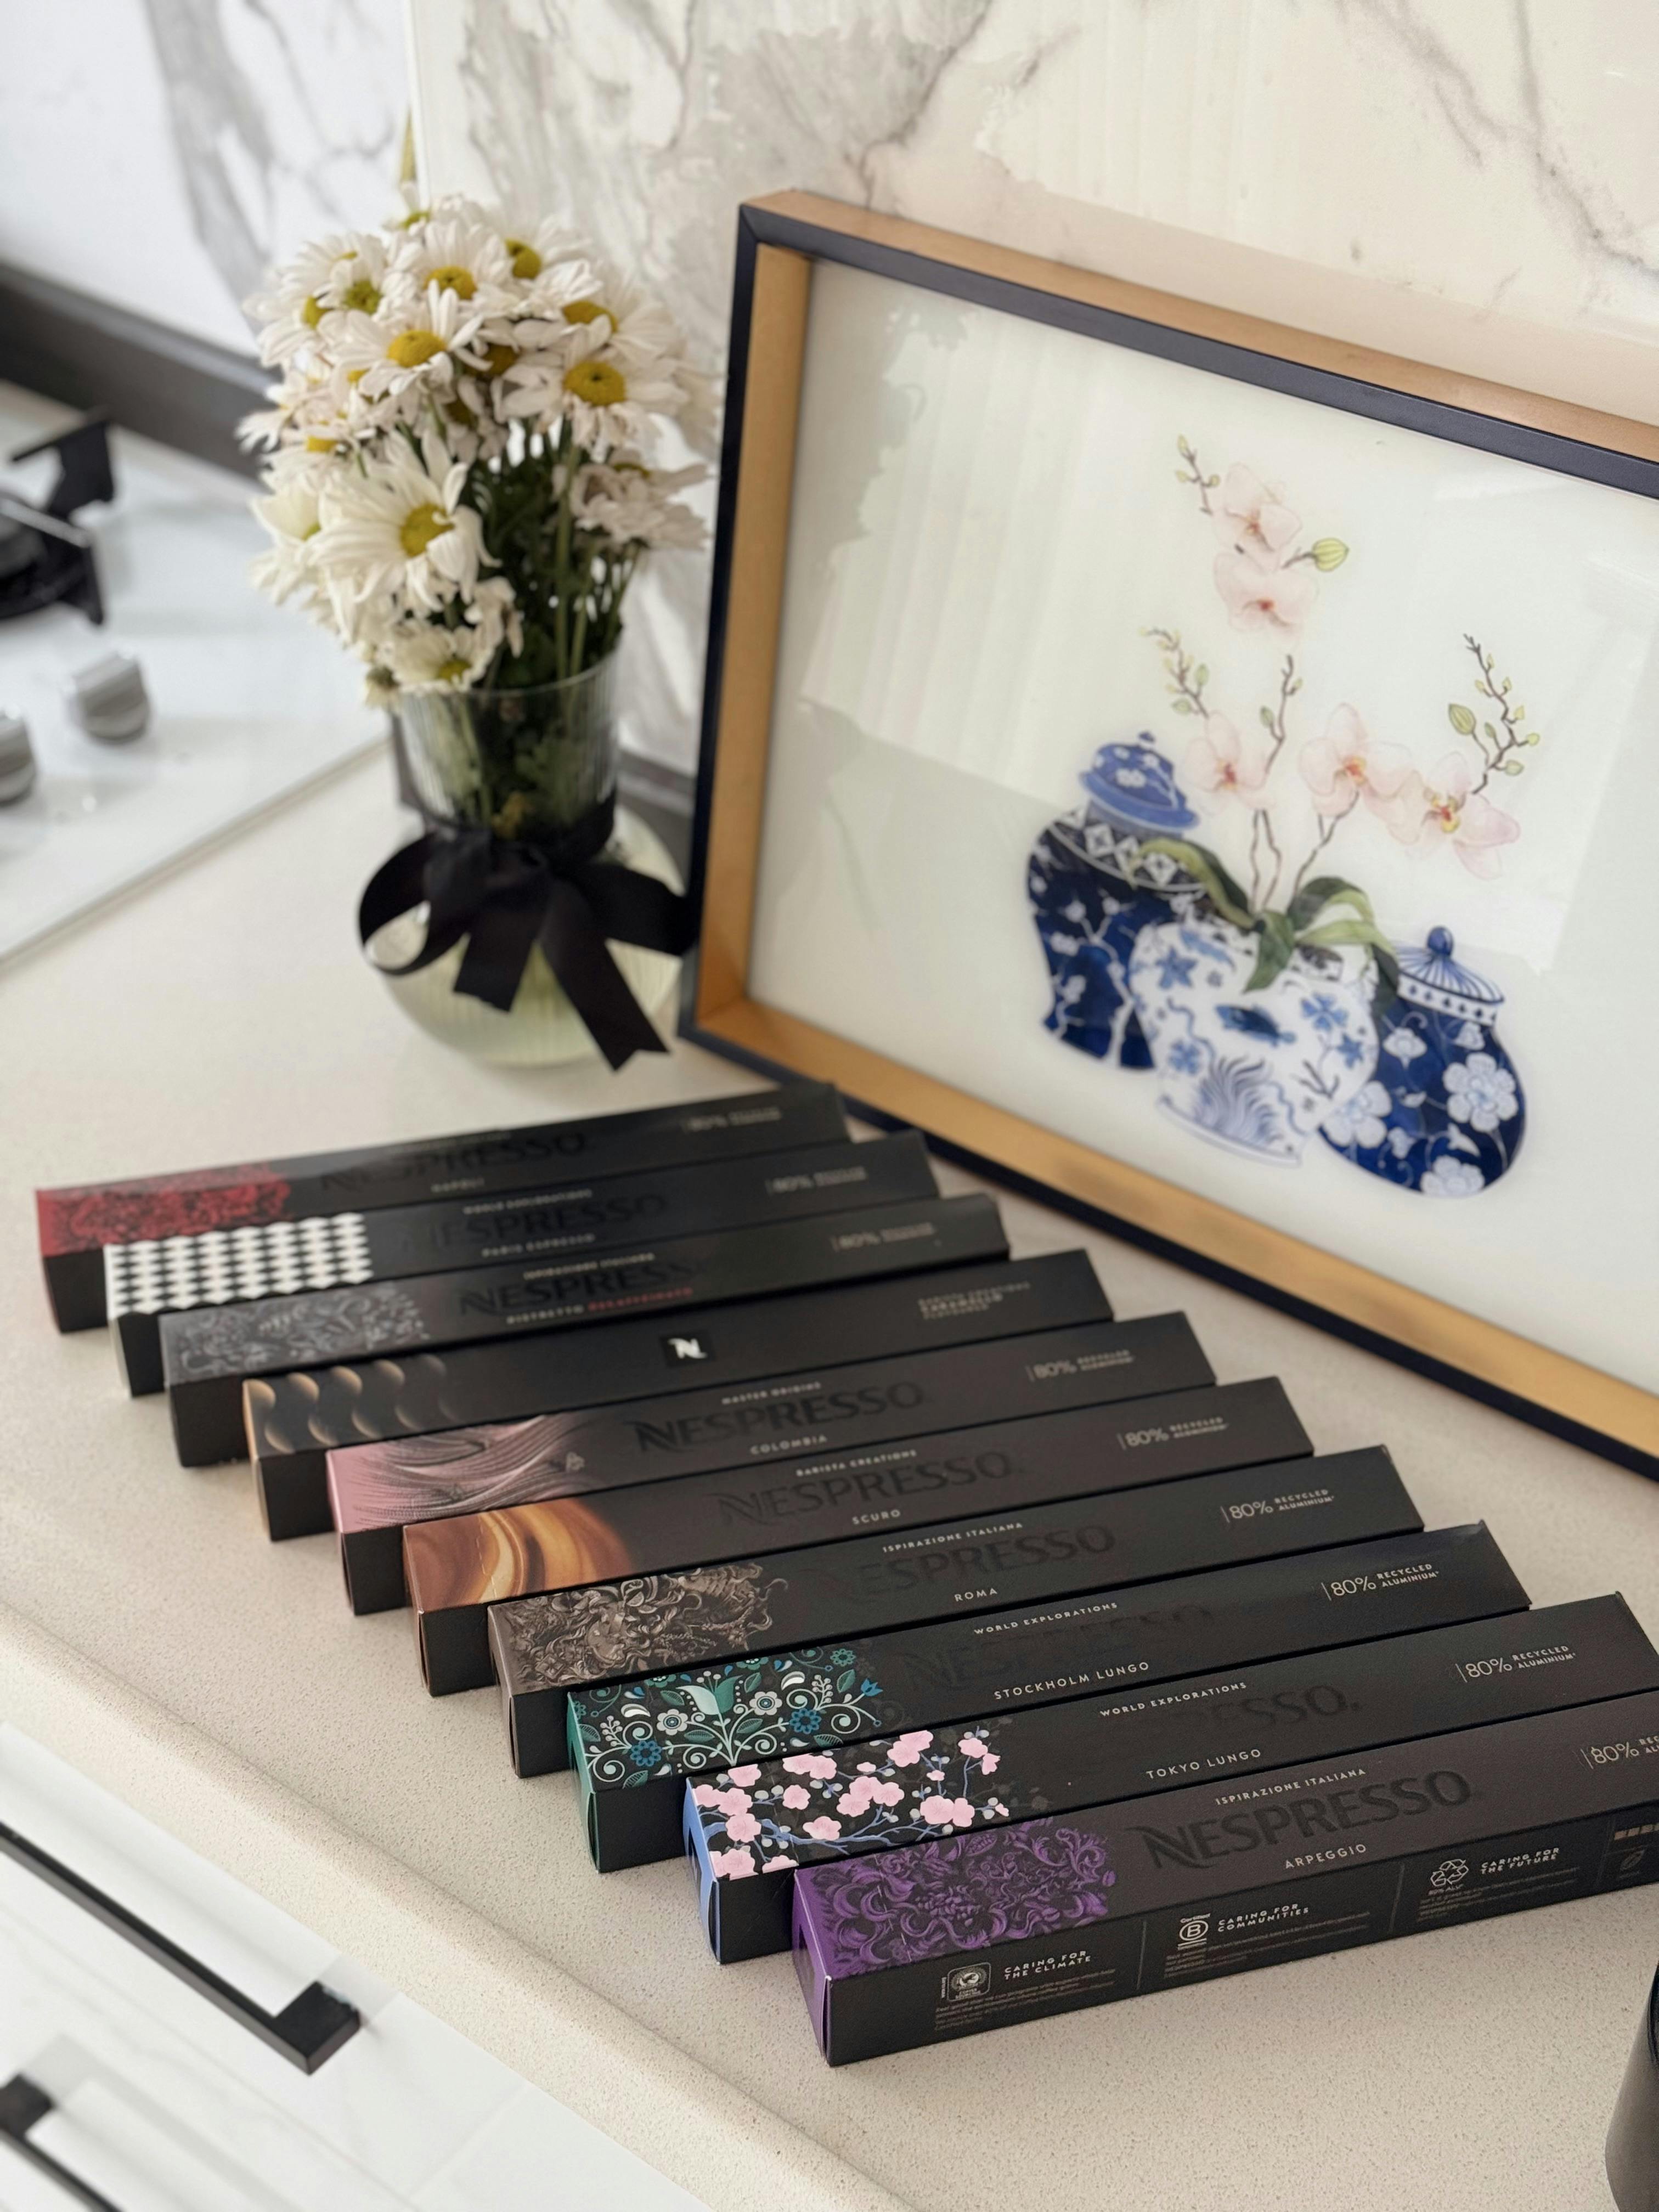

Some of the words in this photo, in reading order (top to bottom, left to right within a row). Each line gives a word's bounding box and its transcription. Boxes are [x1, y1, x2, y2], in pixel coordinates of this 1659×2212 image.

[459, 1262, 696, 1318] NESPRESS
[749, 1433, 827, 1455] COLOMBIA
[1125, 1427, 1170, 1447] 80%
[795, 1462, 846, 1477] BARISTA
[849, 1449, 917, 1468] CREATIONS
[851, 1509, 901, 1525] SCURO
[1229, 1500, 1273, 1519] 80%
[1274, 1489, 1329, 1504] RECYCLED
[882, 1532, 962, 1554] ISPIRAZIONE
[965, 1521, 1023, 1538] ITALIANA
[842, 1525, 1116, 1601] ESPRESSO
[1330, 1576, 1377, 1596] 80%
[1376, 1564, 1432, 1580] RECYCLED
[954, 1588, 998, 1602] ROMA
[974, 1621, 1018, 1635] WORLD
[1023, 1602, 1118, 1626] EXPLORATIONS
[1465, 1657, 1513, 1678] 80%
[1512, 1645, 1569, 1661] RECYCLED
[994, 1673, 1090, 1700] STOCKHOLM
[1096, 1661, 1150, 1681] LUNGO
[1100, 1702, 1146, 1717] WORLD
[1150, 1682, 1247, 1707] EXPLORATIONS
[1146, 1760, 1200, 1780] TOKYO
[1206, 1748, 1262, 1768] LUNGO
[1590, 1742, 1640, 1764] 80%
[1215, 1782, 1301, 1805] ISPIRAZIONE
[1305, 1768, 1367, 1787] ITALIANA
[1125, 1770, 1472, 1869] NESPRESSO
[1284, 1843, 1367, 1869] ARPEGGIO
[1480, 1865, 1504, 1875] THE
[1509, 1853, 1558, 1870] FUTURE
[1481, 1853, 1530, 1869] CARING
[1536, 1847, 1560, 1858] FOR
[1217, 1910, 1268, 1927] CARING
[1274, 1903, 1299, 1914] FOR
[1217, 1907, 1309, 1933] COMMUNITIES
[1004, 1970, 1029, 1980] THE
[1034, 1955, 1092, 1974] CLIMATE
[1005, 1957, 1055, 1974] CARING
[1060, 1950, 1087, 1962] FOR
